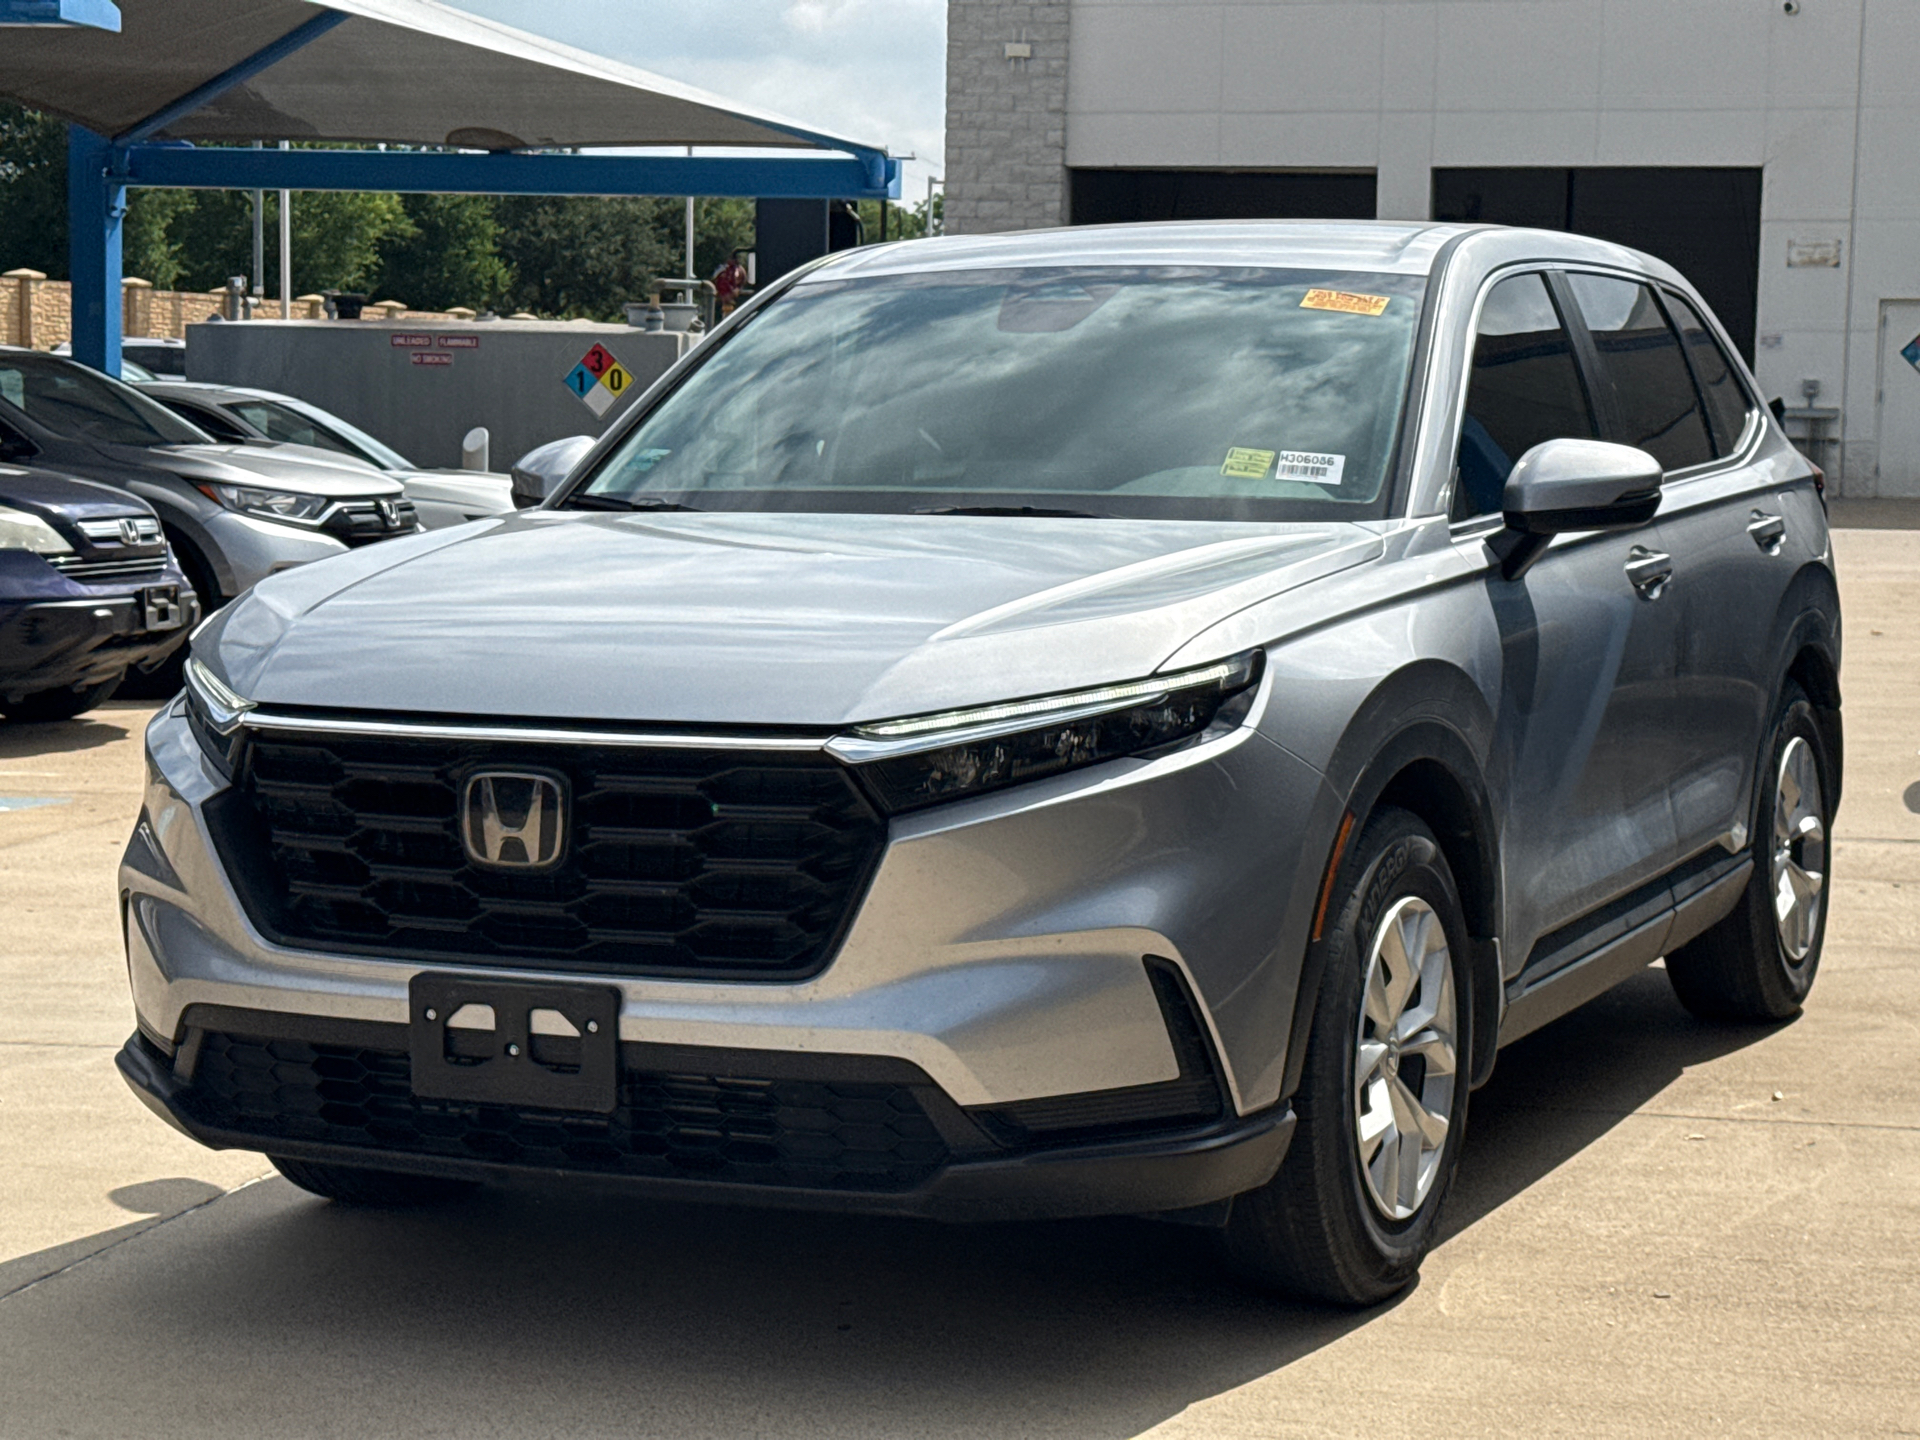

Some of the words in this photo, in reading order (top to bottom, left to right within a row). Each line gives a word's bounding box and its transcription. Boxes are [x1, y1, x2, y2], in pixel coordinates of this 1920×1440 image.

[591, 350, 603, 373] 3
[577, 370, 584, 393] 1
[610, 368, 623, 391] 0
